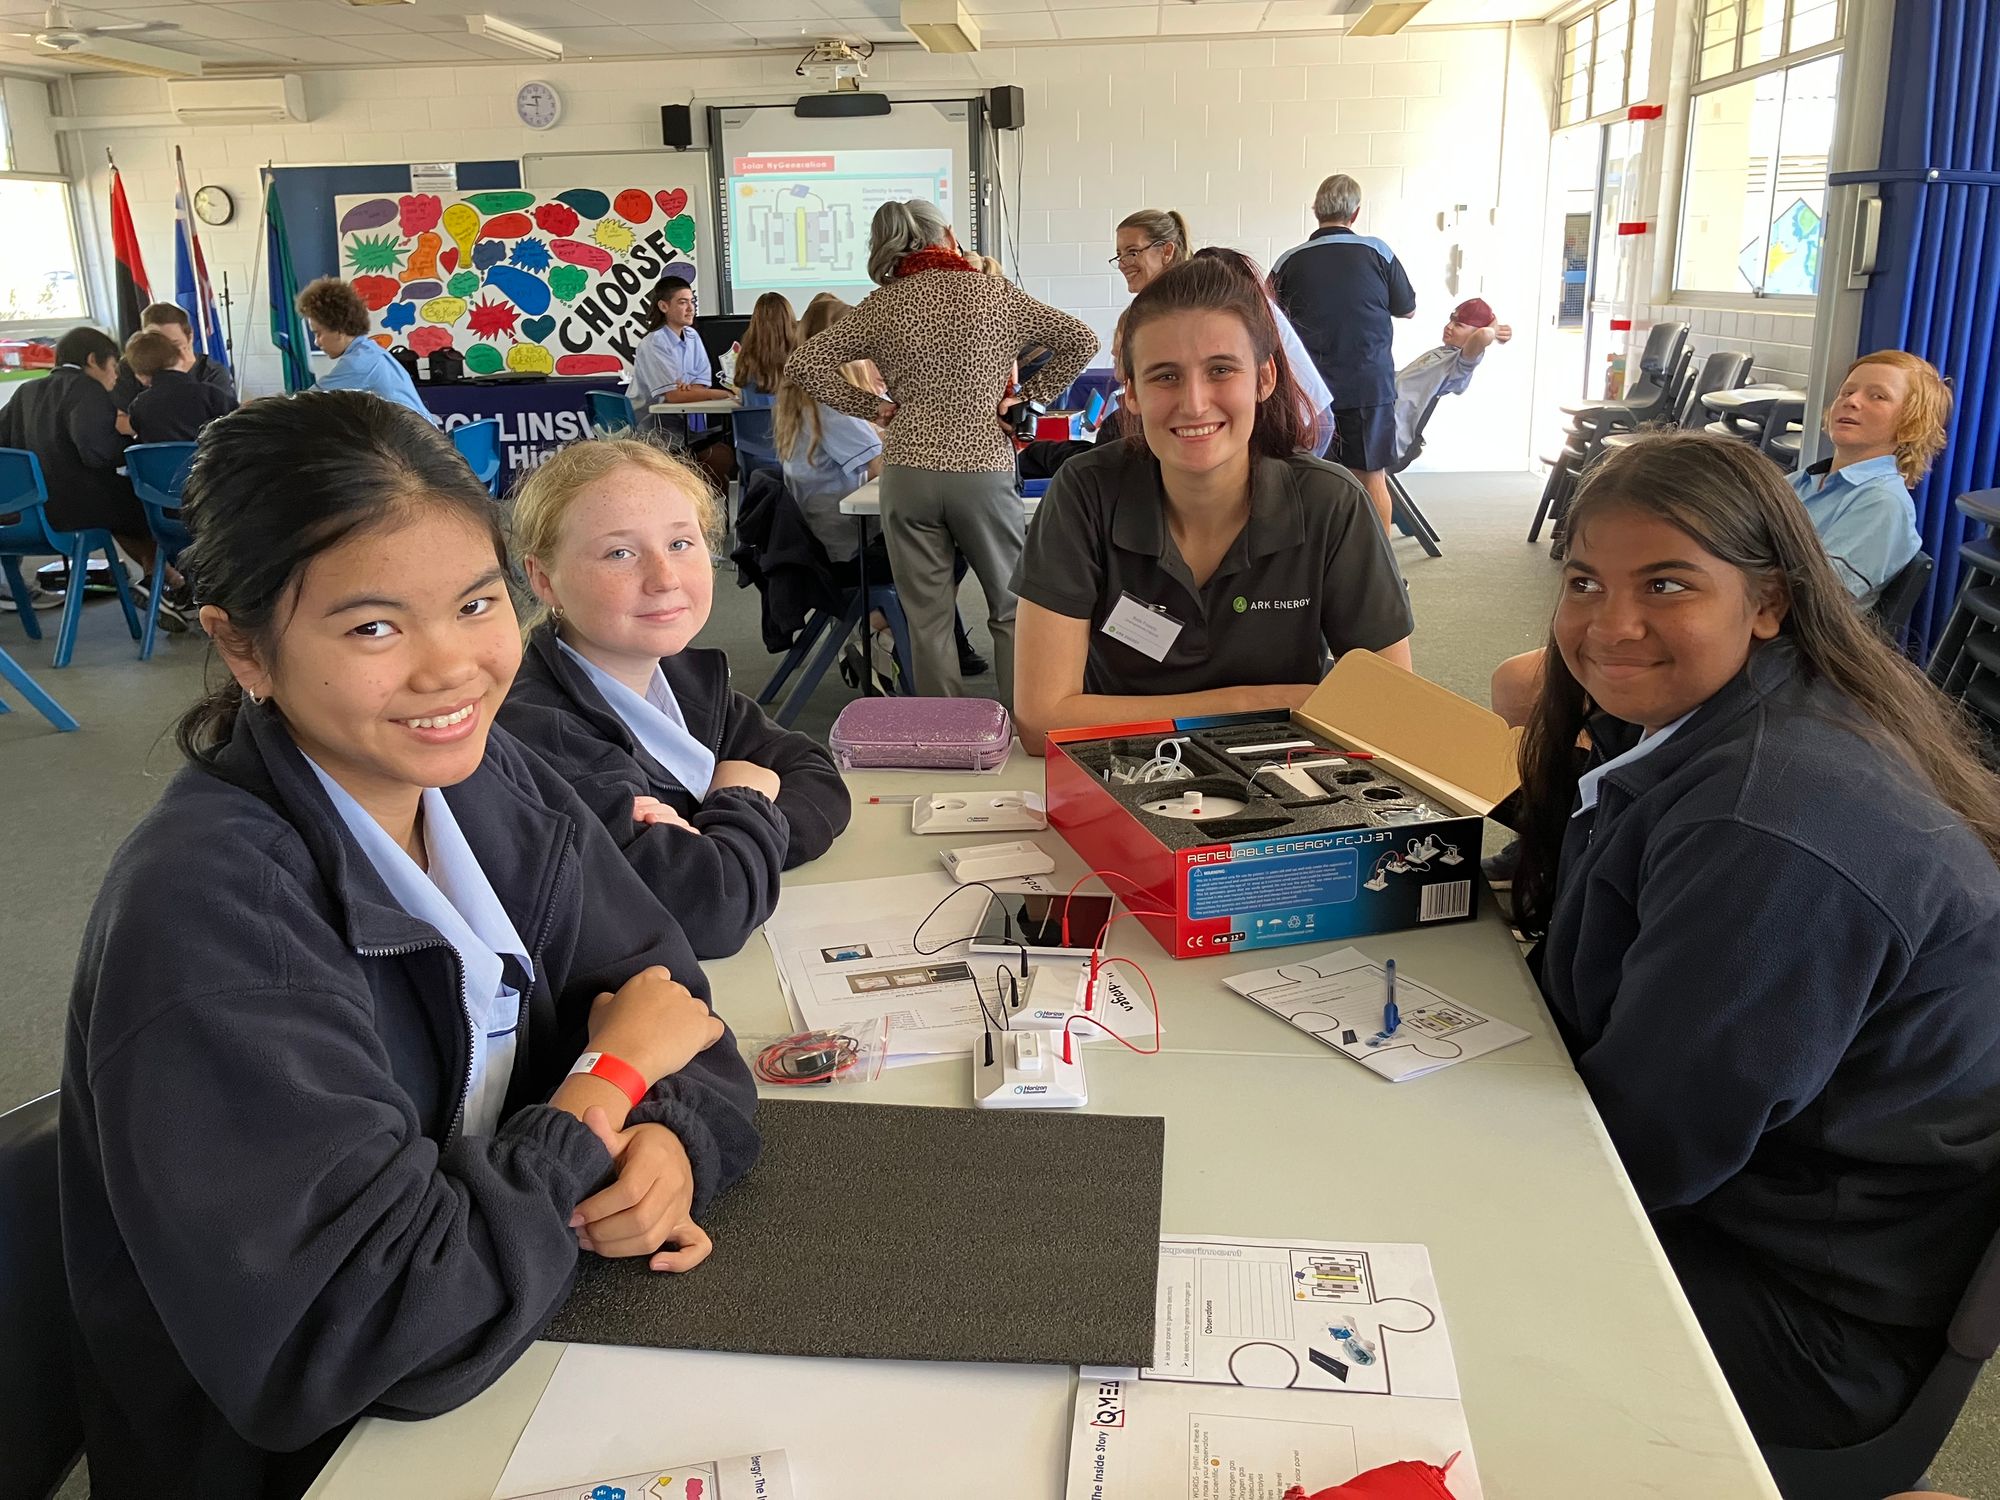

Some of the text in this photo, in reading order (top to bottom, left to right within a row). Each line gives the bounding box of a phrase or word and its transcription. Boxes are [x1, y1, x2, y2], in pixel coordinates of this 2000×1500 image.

[742, 162, 764, 170] Solar
[559, 229, 678, 353] CHOOSE
[431, 411, 598, 442] OLINS
[1250, 598, 1310, 610] ARK ENERGY
[1187, 844, 1274, 864] RENEWABLE
[1276, 838, 1333, 854] ENERGY
[1107, 972, 1134, 1012] drogen
[1091, 1431, 1109, 1500] The Inside Story
[754, 1478, 765, 1494] The
